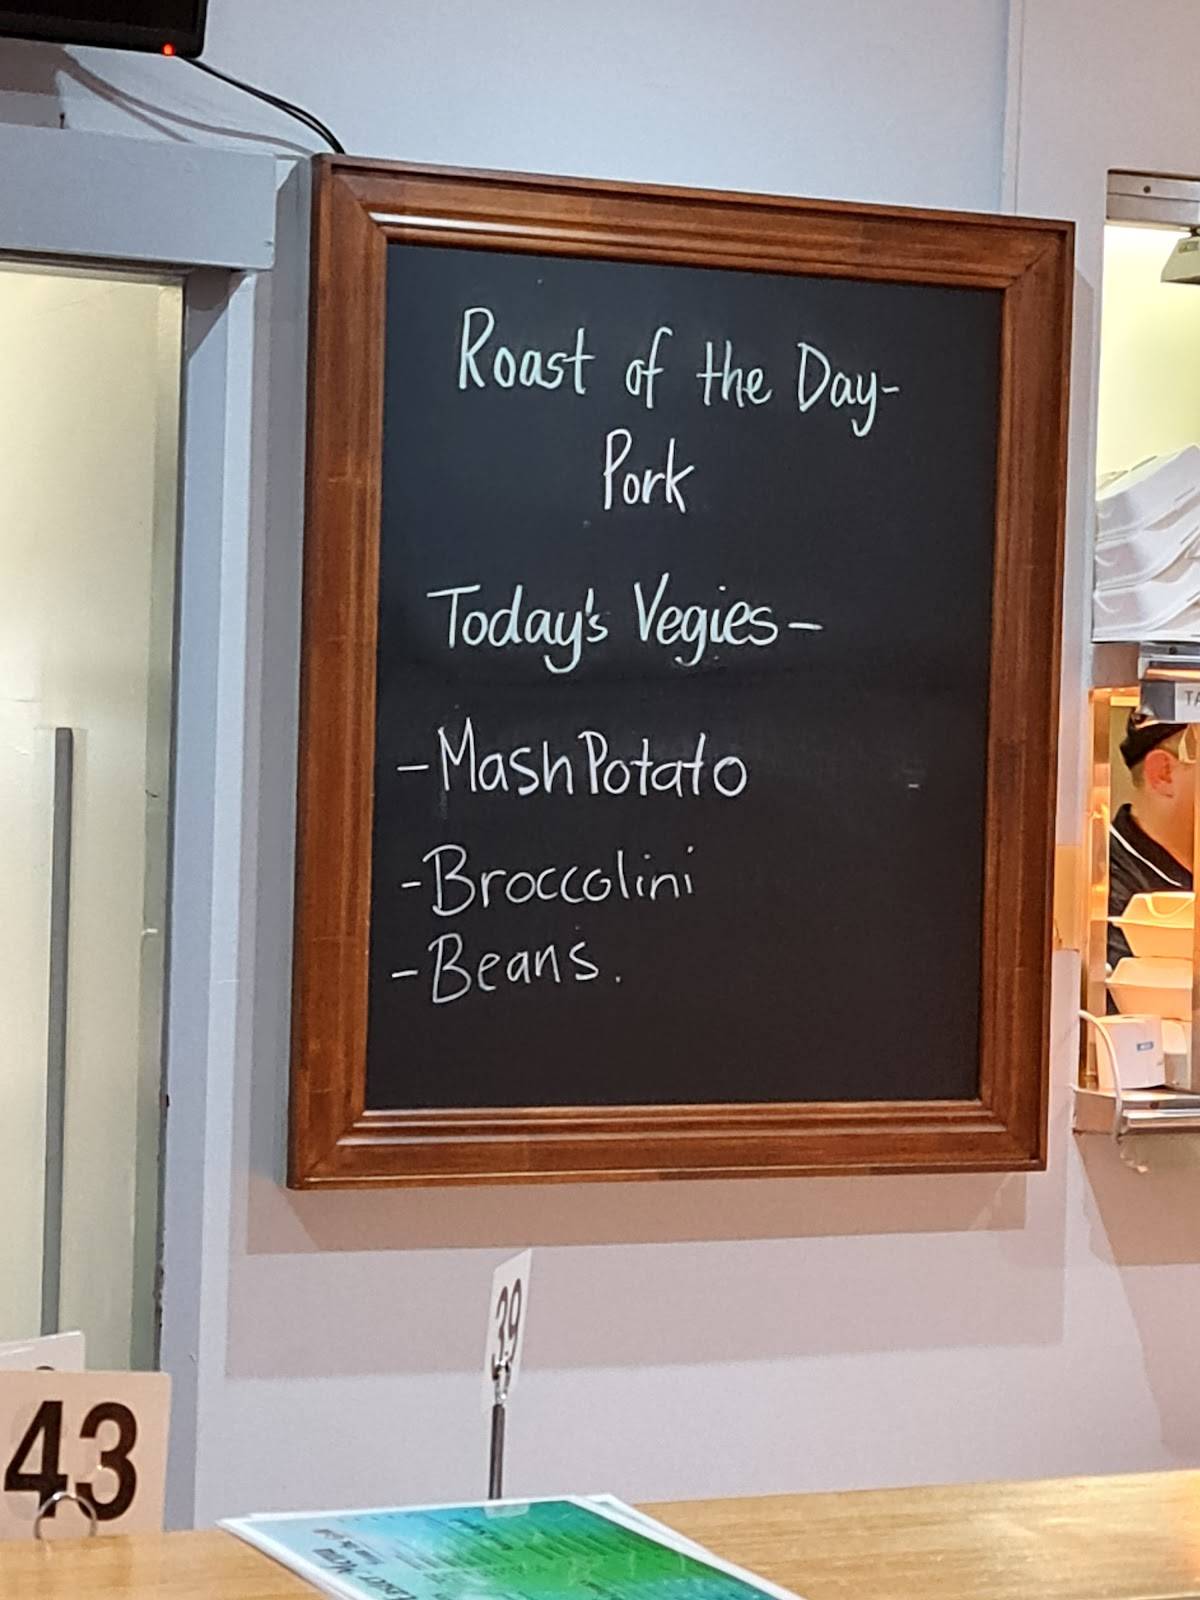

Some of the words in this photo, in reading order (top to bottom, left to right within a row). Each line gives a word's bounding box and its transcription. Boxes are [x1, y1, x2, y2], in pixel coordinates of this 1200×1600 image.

[458, 307, 596, 395] Roast
[625, 326, 673, 409] of
[695, 339, 773, 408] the
[602, 428, 695, 513] Pork
[426, 583, 609, 674] Today's
[491, 1278, 521, 1382] 39
[4, 1400, 137, 1521] 43
